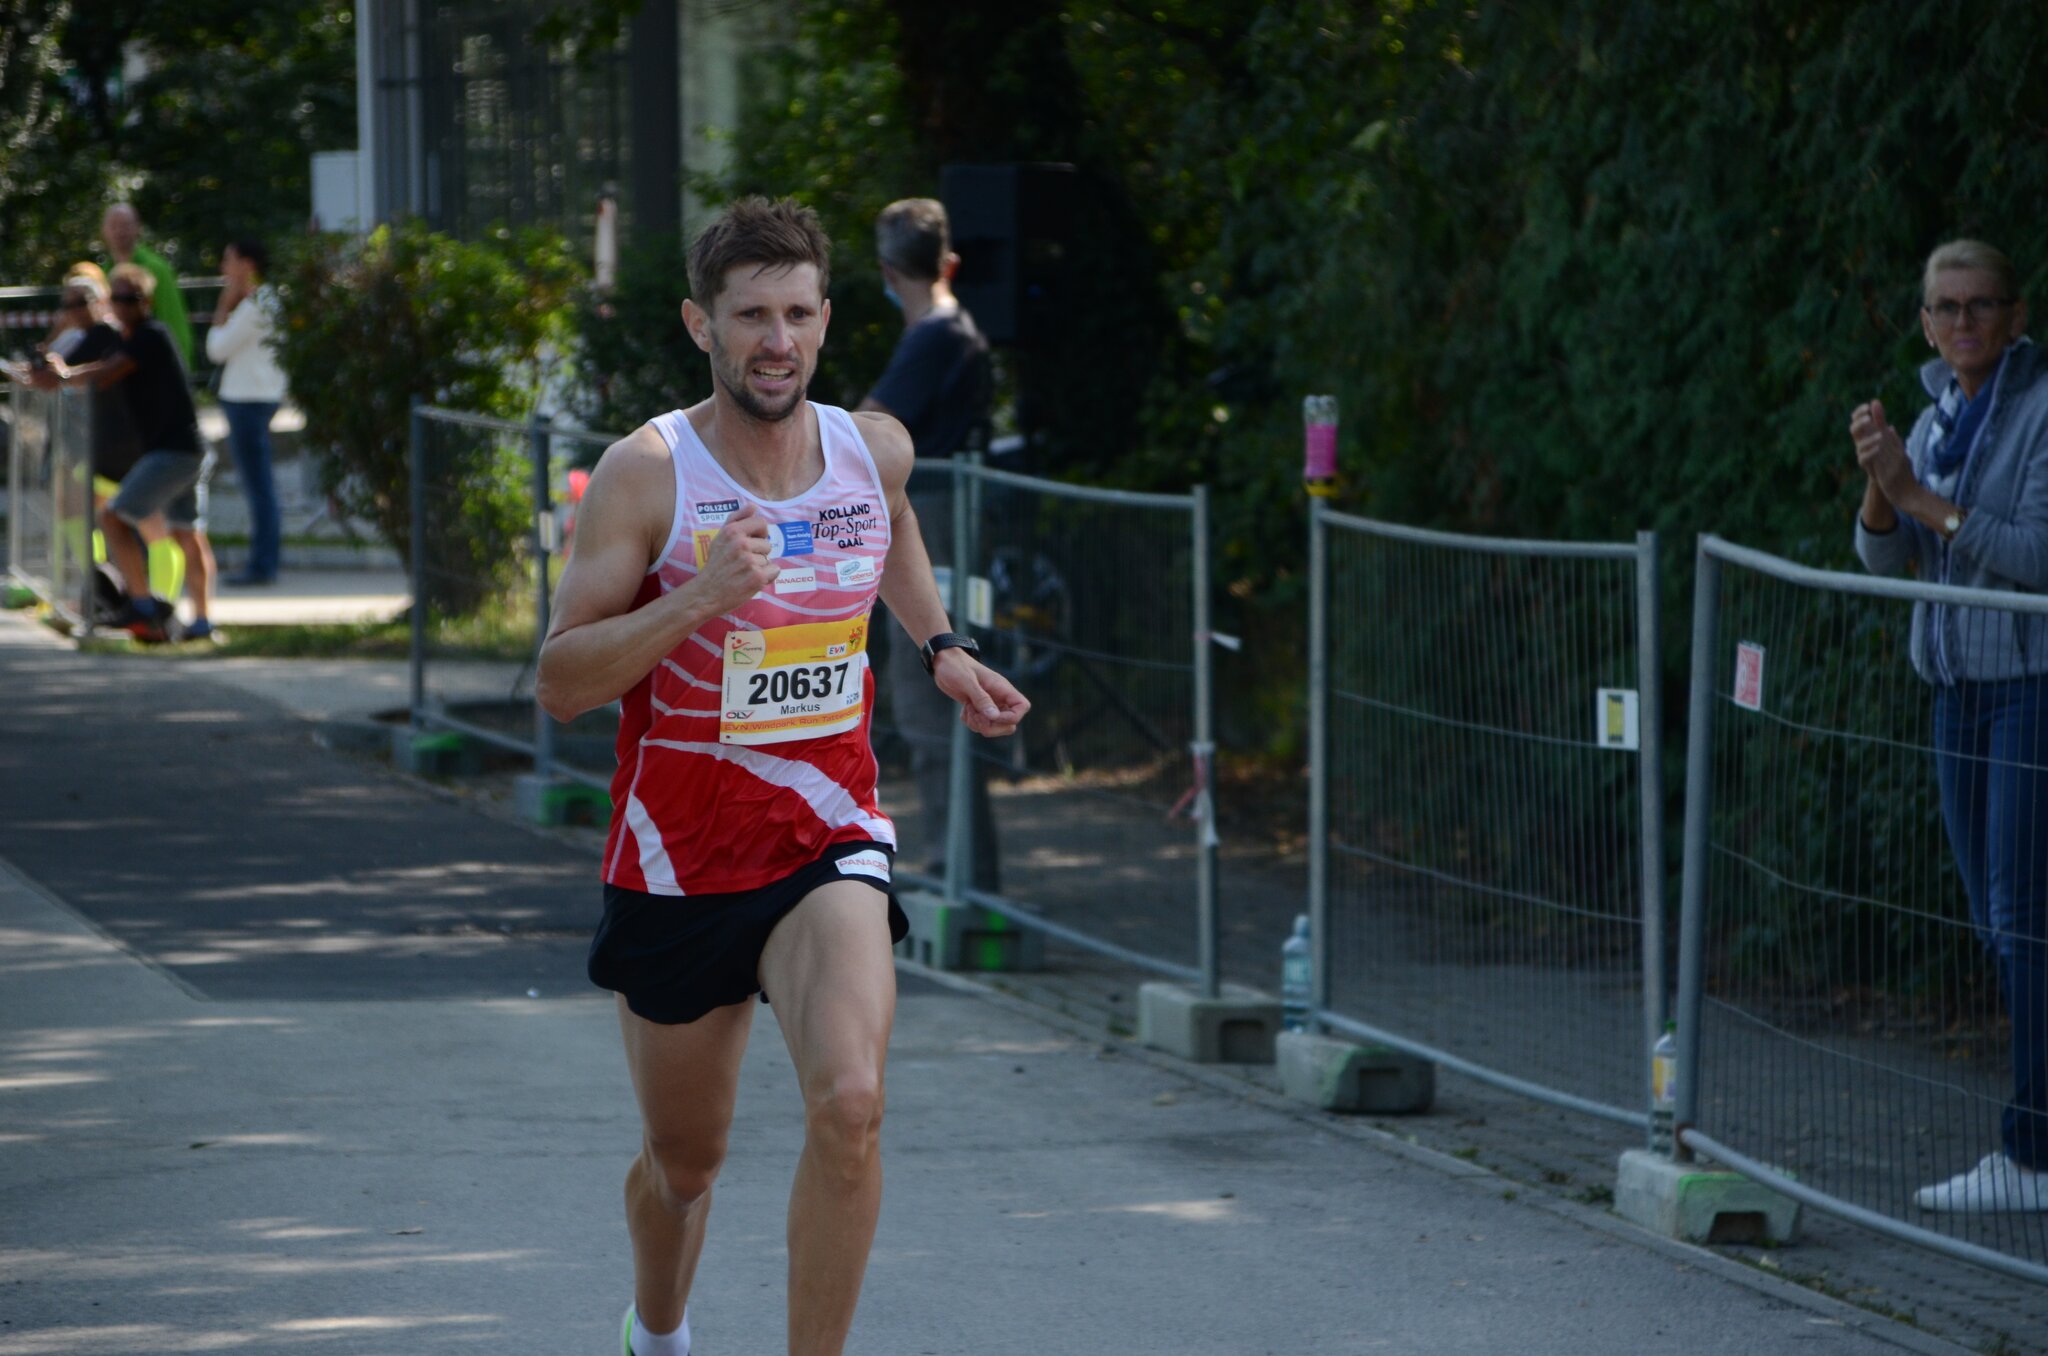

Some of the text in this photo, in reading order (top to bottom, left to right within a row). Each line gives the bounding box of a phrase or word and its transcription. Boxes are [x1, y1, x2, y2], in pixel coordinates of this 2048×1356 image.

[698, 503, 733, 514] POLIZEI
[819, 504, 870, 522] KOLLAND
[701, 514, 725, 522] SPORT
[811, 517, 877, 541] Top-Sport
[838, 537, 864, 549] GAAL
[776, 576, 814, 585] PANACEO
[829, 645, 845, 655] EVN
[747, 662, 849, 705] 20637
[780, 703, 820, 715] Markus
[752, 719, 796, 730] Windpark
